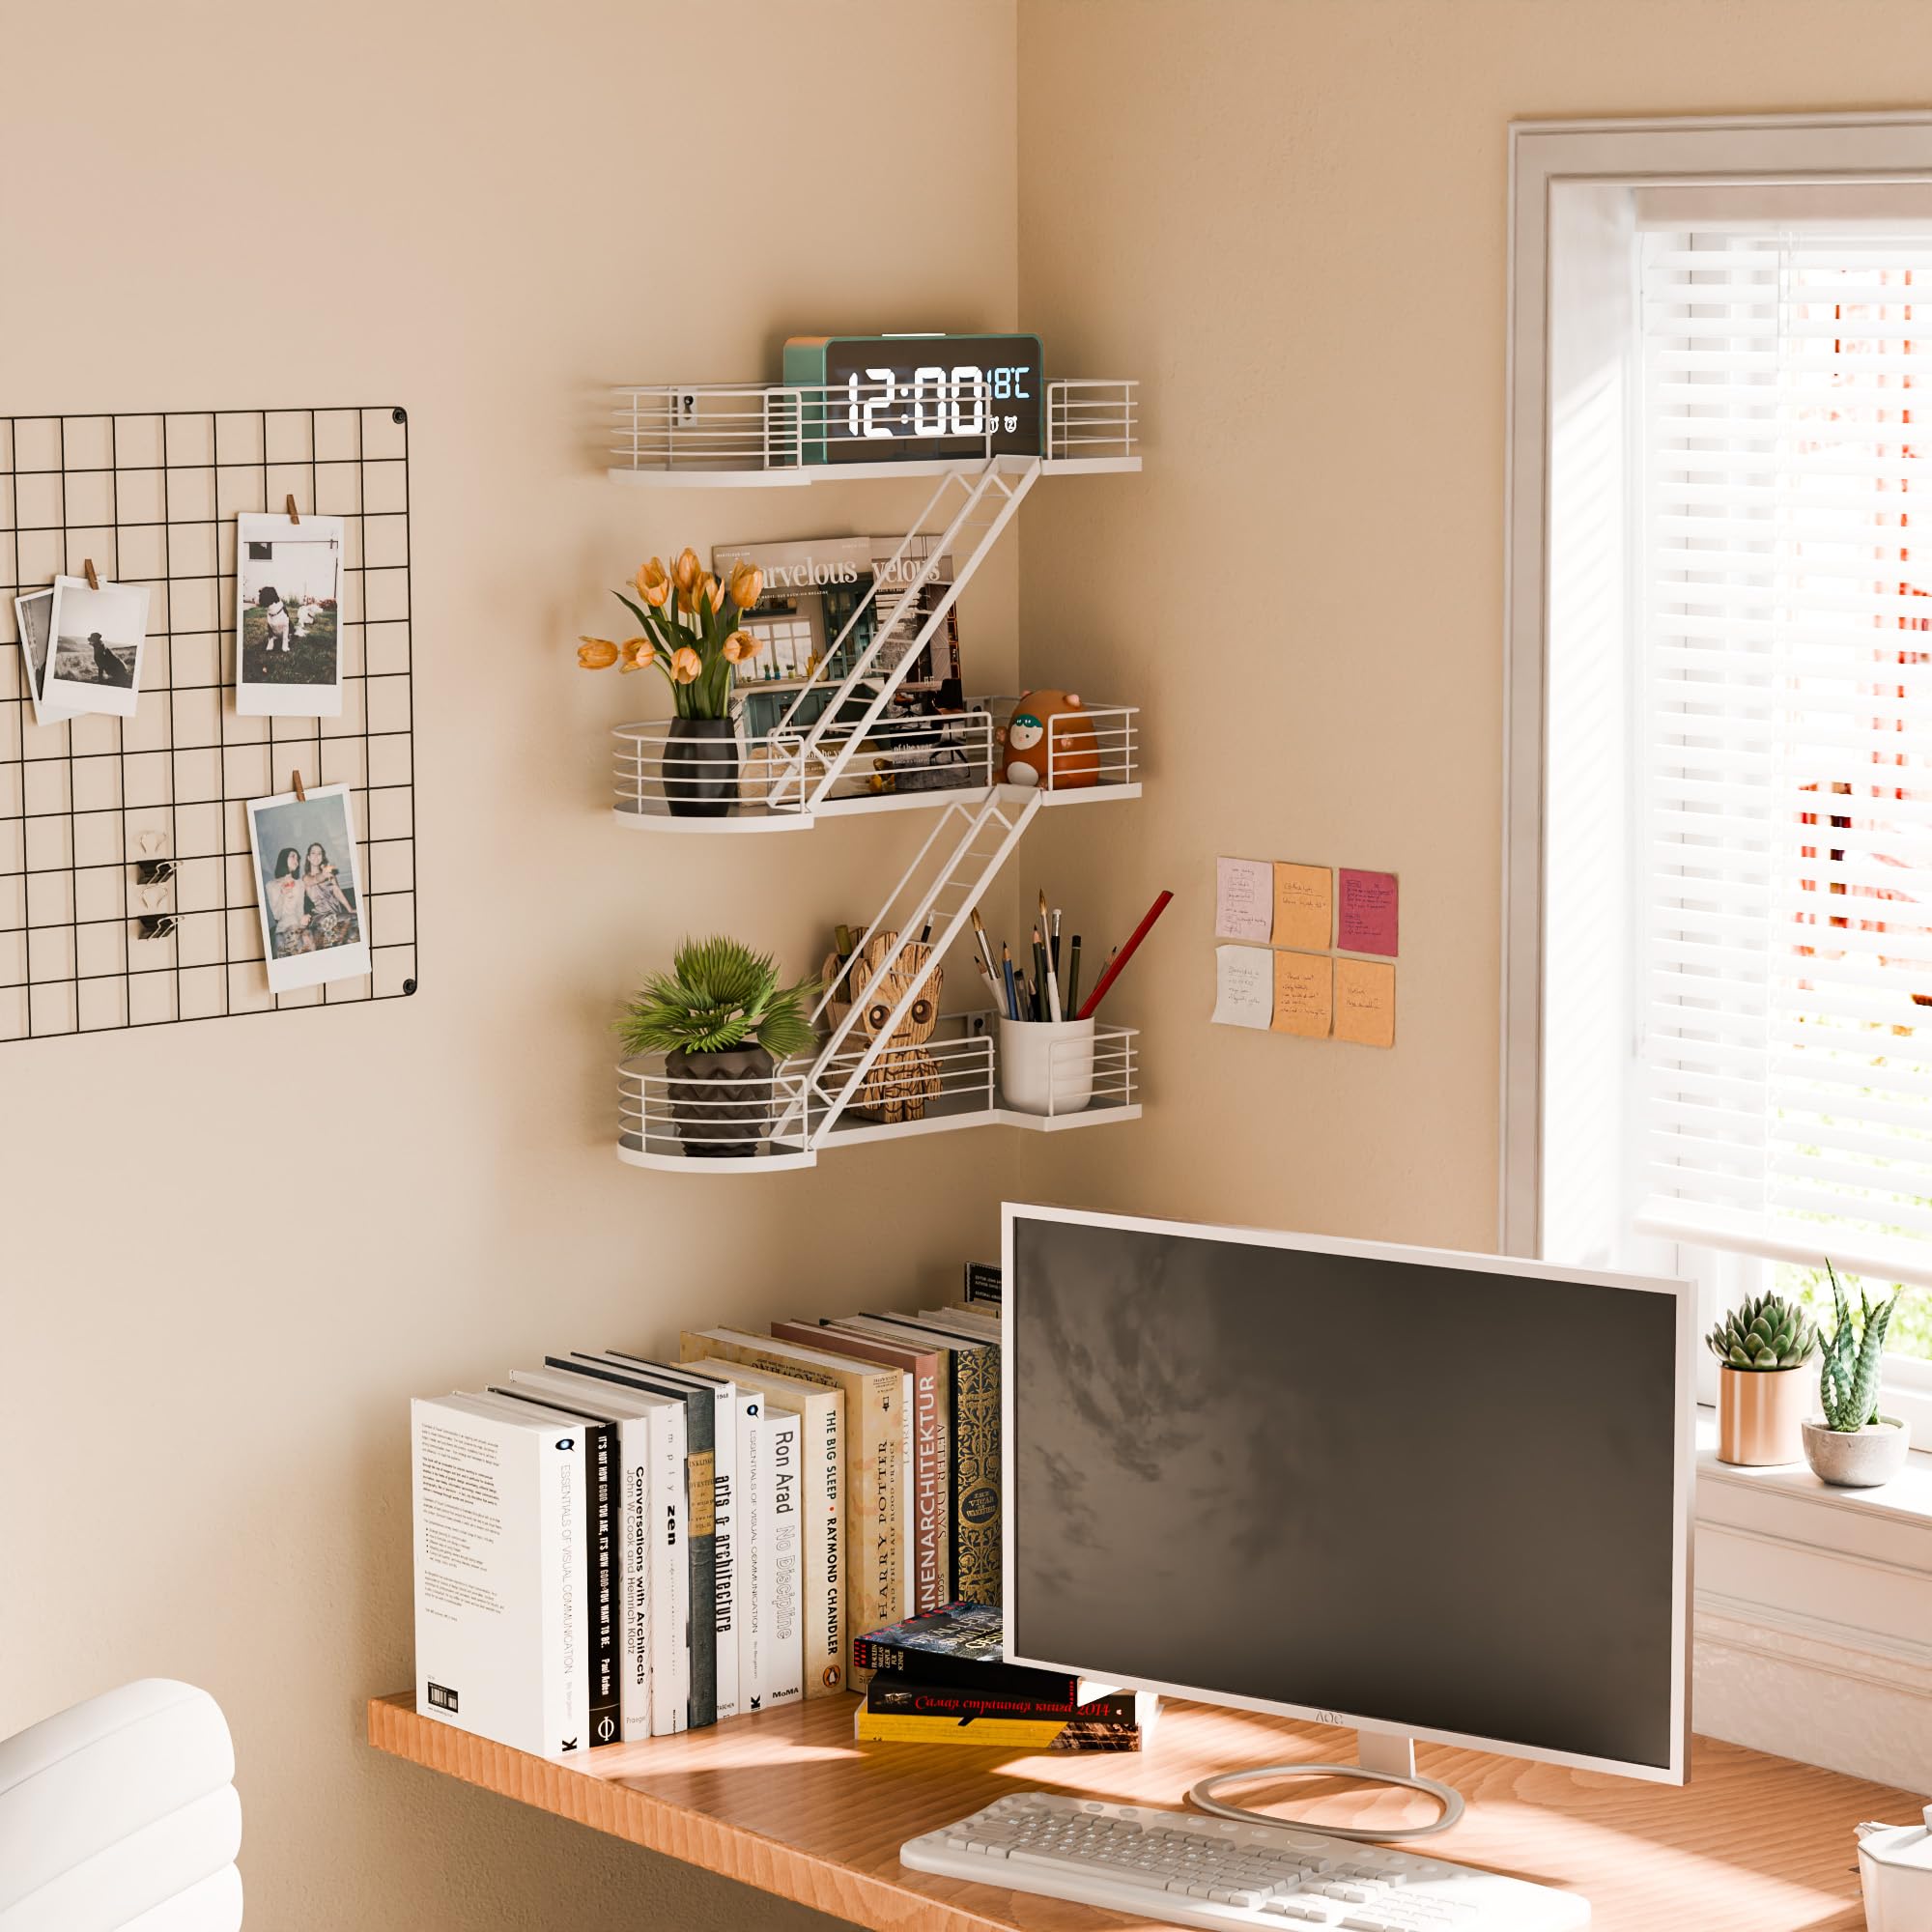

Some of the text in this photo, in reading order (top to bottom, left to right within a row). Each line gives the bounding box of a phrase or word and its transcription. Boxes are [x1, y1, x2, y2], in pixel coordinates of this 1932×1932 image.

[848, 366, 983, 437] 12:00
[598, 1451, 608, 1464] NOT
[826, 1409, 837, 1500] THE BIG SLEEP
[598, 1466, 608, 1482] HOW
[715, 1475, 732, 1507] arts
[937, 1423, 948, 1539] AFTER DAYS
[560, 1465, 571, 1526] ESSENTIALS
[599, 1484, 608, 1502] GOOD
[599, 1503, 609, 1518] YOU
[751, 1492, 757, 1506] OF
[562, 1529, 572, 1543] OF
[636, 1466, 644, 1571] Conversations
[668, 1505, 676, 1546] zen
[772, 1431, 796, 1640] Ron Arad No Discipline
[877, 1439, 889, 1621] HARRY POTTER
[562, 1546, 573, 1582] VISUAL
[600, 1552, 609, 1567] HOW
[600, 1569, 610, 1587] GOOD
[715, 1533, 734, 1634] architecture
[827, 1517, 838, 1656] RAYMOND CHANDLER
[600, 1589, 610, 1604] YOU
[600, 1604, 610, 1624] WANT
[627, 1577, 636, 1624] Heinrich
[562, 1585, 574, 1674] COMMUNICATION
[600, 1625, 610, 1634] TO
[637, 1612, 645, 1685] Architects
[601, 1659, 611, 1695] Paul Arden
[772, 1687, 799, 1699] MoMA
[915, 1695, 1111, 1718] Самая страшная книга 2014
